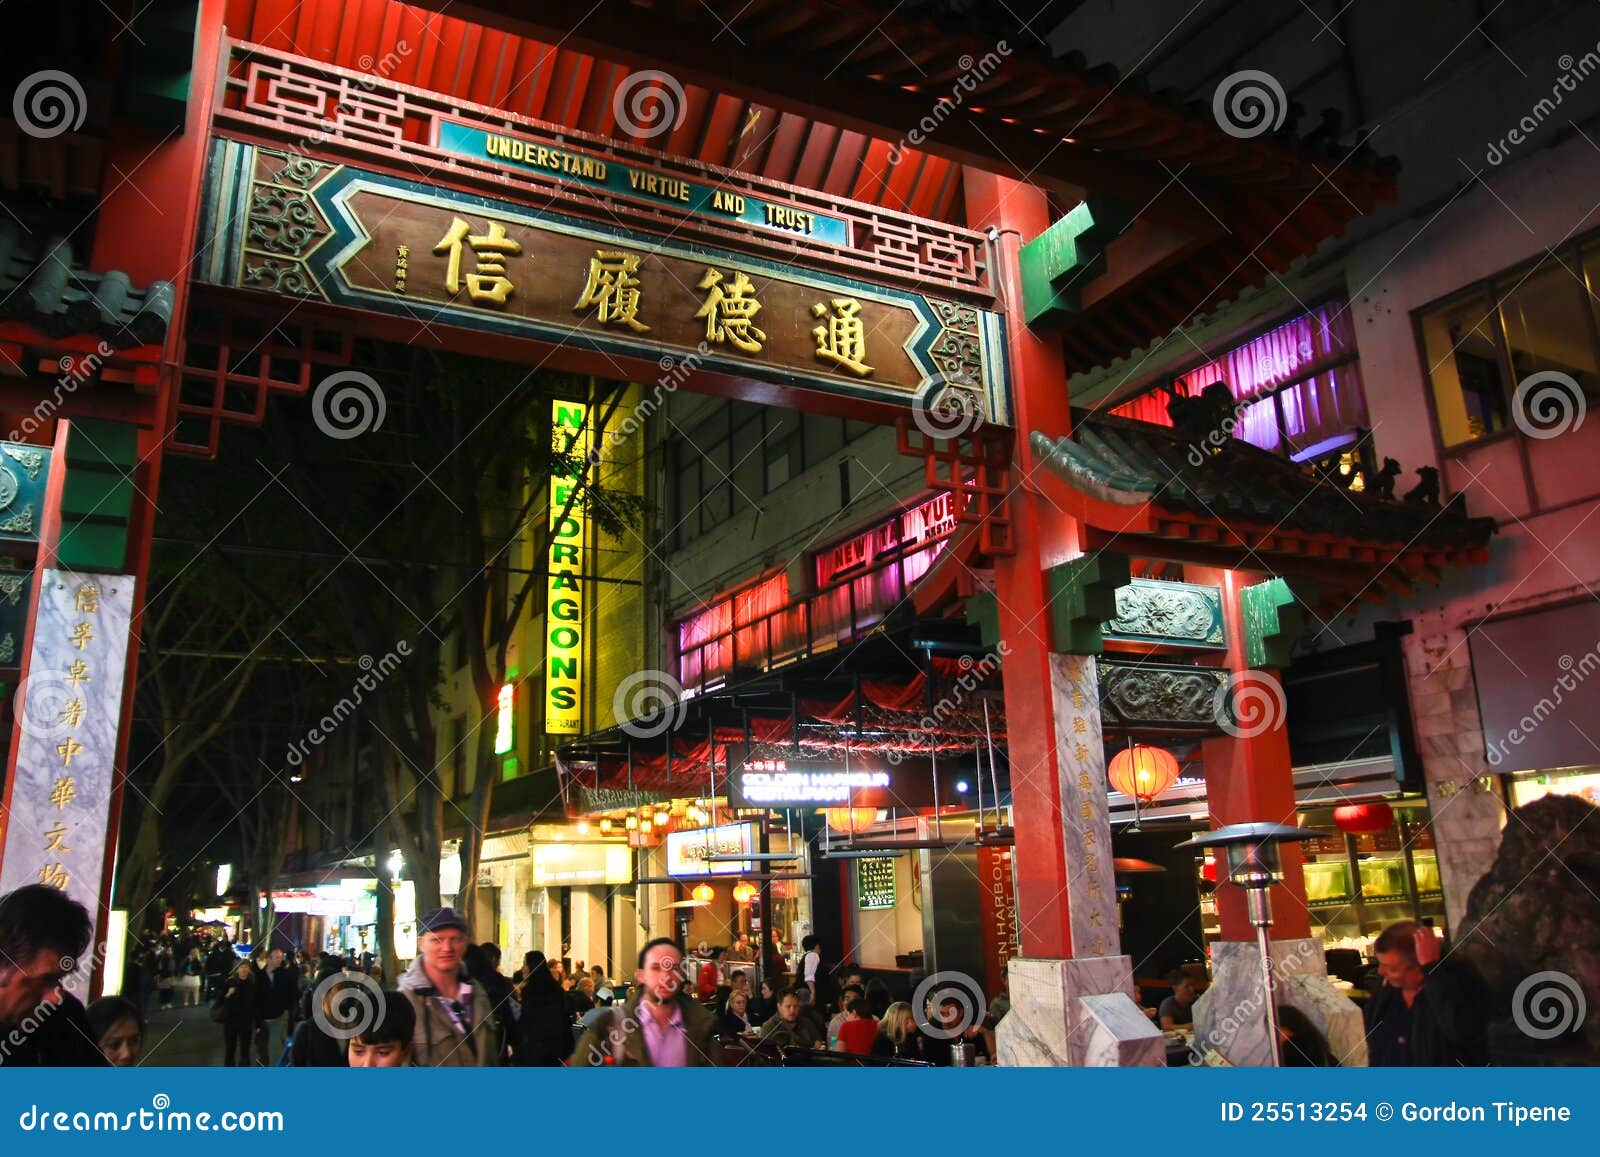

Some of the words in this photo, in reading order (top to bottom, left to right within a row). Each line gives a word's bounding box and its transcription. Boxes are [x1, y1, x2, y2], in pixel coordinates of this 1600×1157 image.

[486, 134, 607, 181] UNDERSTAND
[629, 169, 690, 201] VIRTUE
[713, 191, 745, 215] AND
[766, 204, 815, 232] TRUST
[550, 516, 580, 709] DRAGONS
